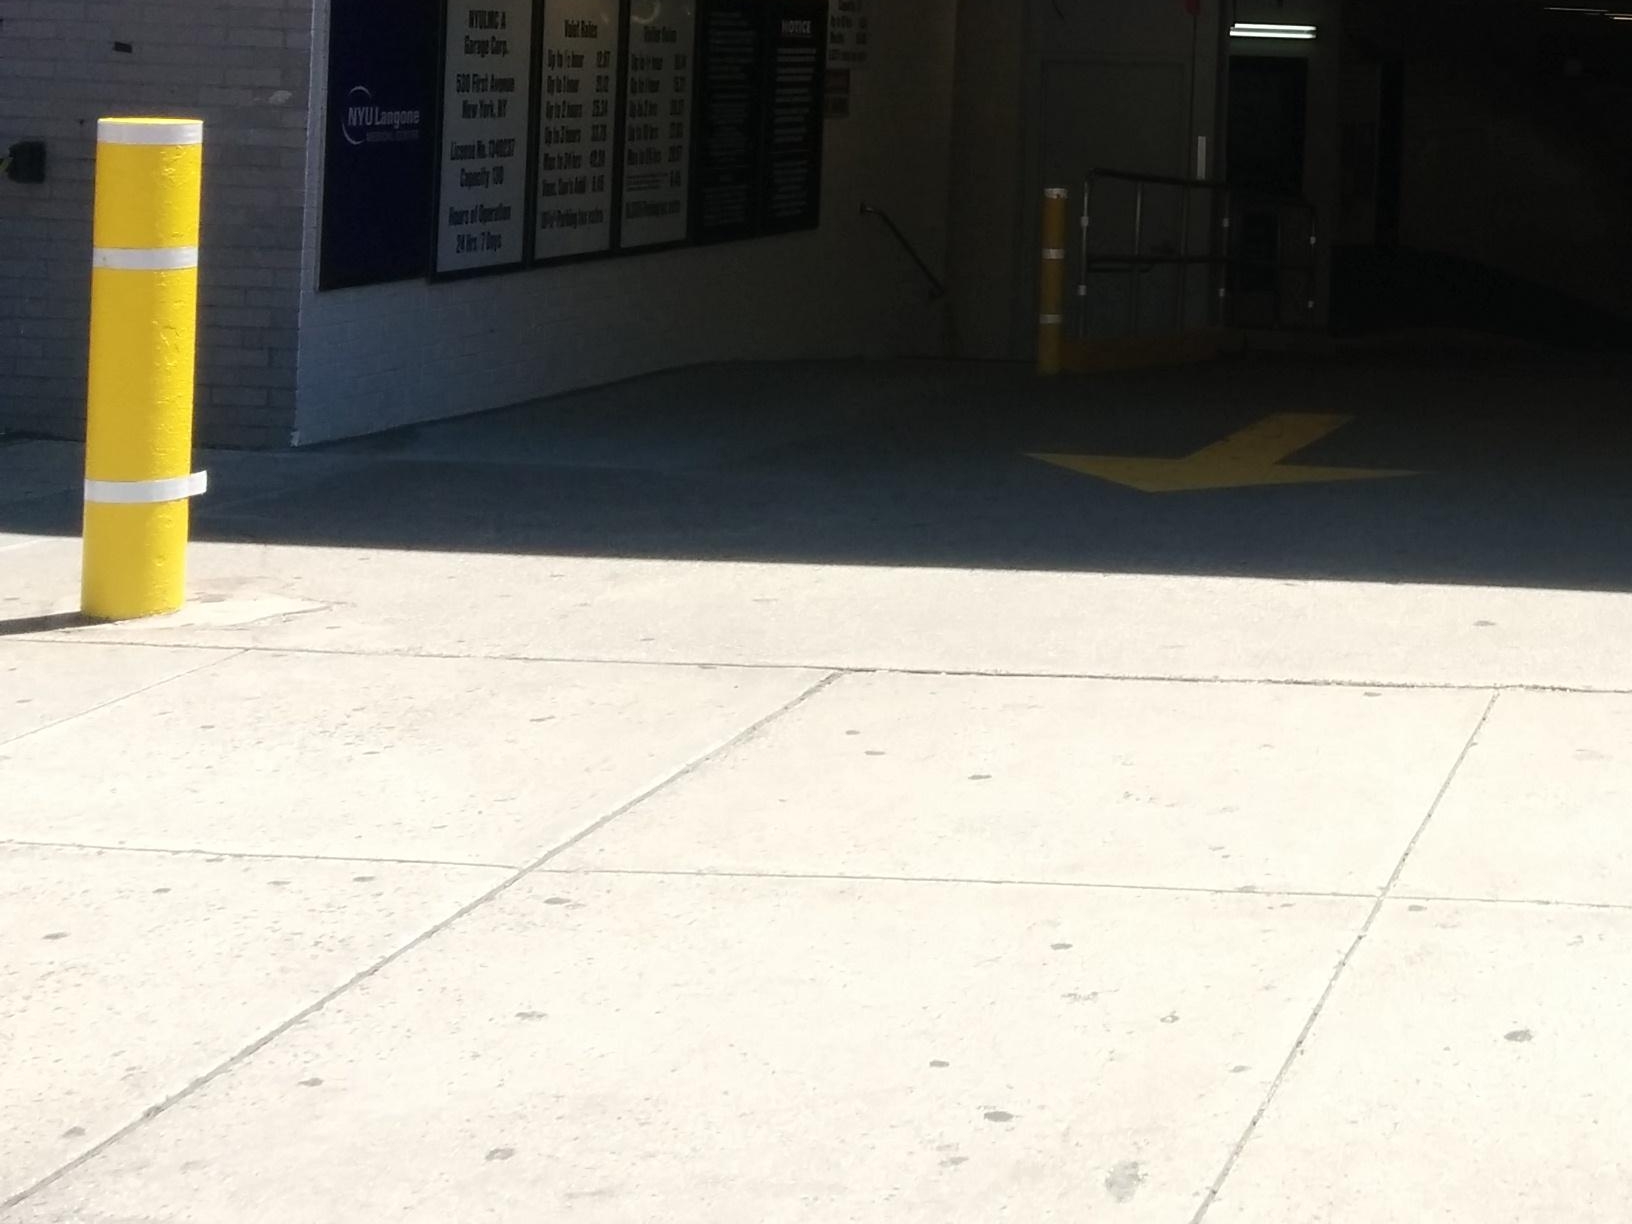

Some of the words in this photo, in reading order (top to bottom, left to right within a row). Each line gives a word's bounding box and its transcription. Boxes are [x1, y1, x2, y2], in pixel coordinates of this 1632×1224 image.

[782, 20, 812, 34] NOTICE
[464, 35, 489, 57] Garage
[472, 74, 488, 92] First
[348, 107, 373, 126] NYU
[374, 107, 420, 129] Langone
[462, 100, 477, 118] New
[460, 167, 490, 188] Capacity
[449, 207, 469, 225] Hours
[470, 206, 478, 224] of
[479, 203, 511, 223] Operation
